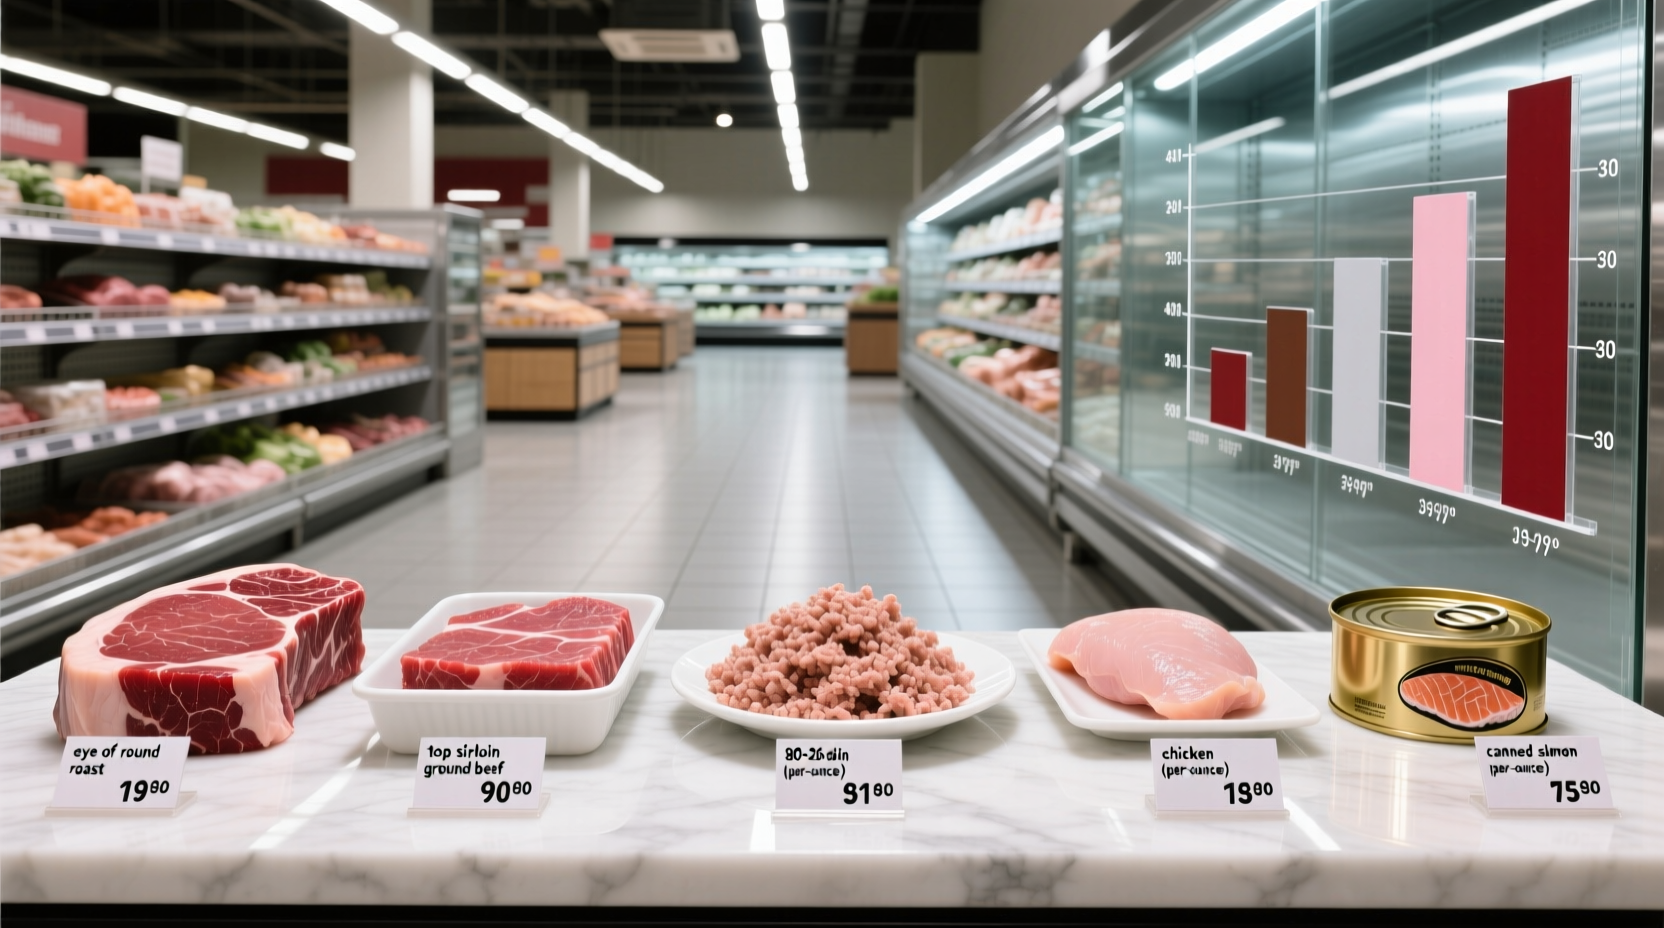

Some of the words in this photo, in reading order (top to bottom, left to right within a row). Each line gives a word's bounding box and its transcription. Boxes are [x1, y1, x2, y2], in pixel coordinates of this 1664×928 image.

[1598, 158, 1619, 178] 30
[1597, 248, 1617, 269] 30
[1595, 340, 1616, 359] 30
[1593, 430, 1614, 451] 30
[73, 747, 98, 761] eye
[102, 743, 118, 758] of
[120, 744, 161, 758] round
[427, 745, 451, 761] top
[456, 743, 500, 759] sirloin
[1162, 745, 1214, 760] chicken
[1486, 744, 1533, 758] canned
[69, 763, 105, 775] roast
[423, 761, 471, 778] ground
[474, 760, 505, 775] beef
